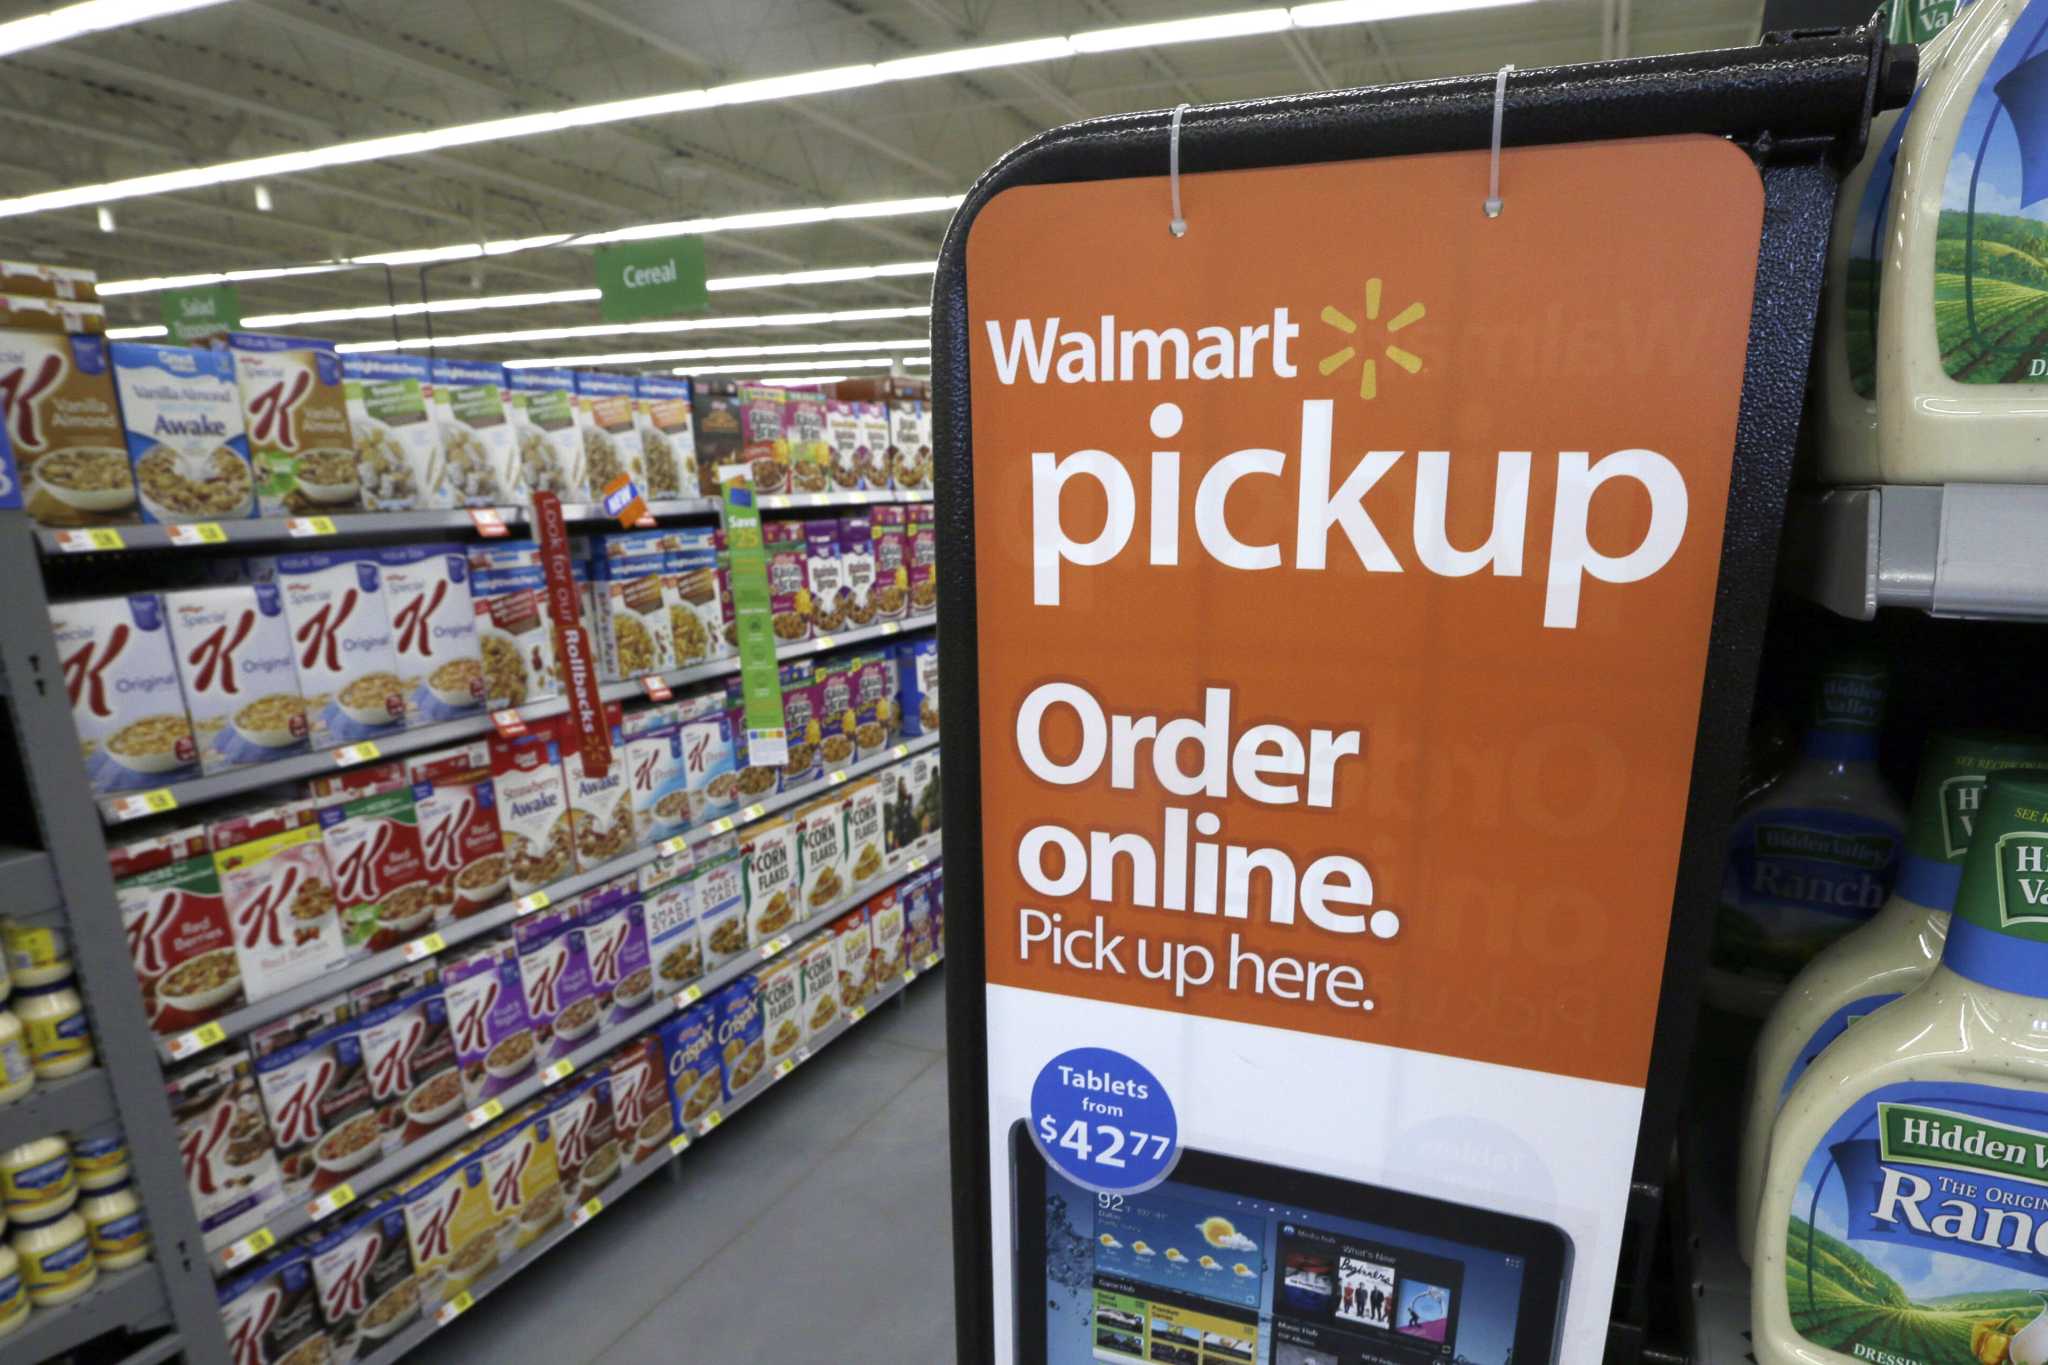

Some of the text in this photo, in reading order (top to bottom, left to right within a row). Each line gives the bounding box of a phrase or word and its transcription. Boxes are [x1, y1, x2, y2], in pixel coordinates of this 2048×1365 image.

[622, 259, 677, 289] Cereal
[985, 307, 1300, 386] Walmart
[153, 414, 226, 436] Awake
[727, 516, 757, 529] Save
[1031, 399, 1690, 630] pickup
[297, 588, 359, 672] K
[393, 579, 448, 656] K
[433, 623, 474, 639] Original
[188, 609, 255, 694] K
[343, 636, 390, 652] Original
[241, 656, 291, 674] Original
[115, 674, 177, 694] Original
[564, 628, 596, 735] Rollbacks
[1016, 682, 1361, 809] Order
[577, 773, 621, 797] Awake
[510, 792, 559, 819] Awake
[852, 802, 879, 826] CORN
[425, 798, 472, 868] K
[808, 822, 837, 849] CORN
[854, 820, 879, 843] FLAKES
[1765, 830, 1887, 863] Hidden Valley
[336, 823, 391, 899] K
[755, 845, 788, 873] CORN
[810, 842, 838, 866] FLAKES
[702, 874, 737, 897] SMART
[758, 865, 791, 892] FLAKES
[1017, 806, 1400, 939] online.
[1752, 861, 1884, 909] Ranch
[239, 866, 298, 949] K
[651, 896, 690, 921] SMART
[652, 908, 691, 934] START
[173, 929, 225, 950] Berries
[180, 918, 211, 936] Red
[592, 923, 630, 983] K
[808, 955, 833, 980] CORN
[1018, 908, 1375, 1011] Pick up here.
[529, 949, 567, 1016] K
[767, 979, 795, 1006] CORN
[809, 972, 835, 996] FLAKES
[457, 981, 498, 1053] K
[718, 999, 760, 1046] Crispix
[768, 995, 797, 1022] FLAKES
[372, 1020, 423, 1098] K
[669, 1025, 716, 1076] Crispix
[1057, 1064, 1149, 1100] Tablets
[275, 1061, 333, 1144] K
[616, 1065, 650, 1131] K
[1081, 1096, 1124, 1118] from
[557, 1102, 595, 1167] K
[1902, 1116, 2027, 1166] Hidden
[493, 1141, 533, 1212] K
[1937, 1176, 1978, 1200] THE
[1097, 1191, 1124, 1213] 92
[417, 1186, 463, 1263] K
[1342, 1244, 1374, 1259] What's
[326, 1235, 380, 1321] K
